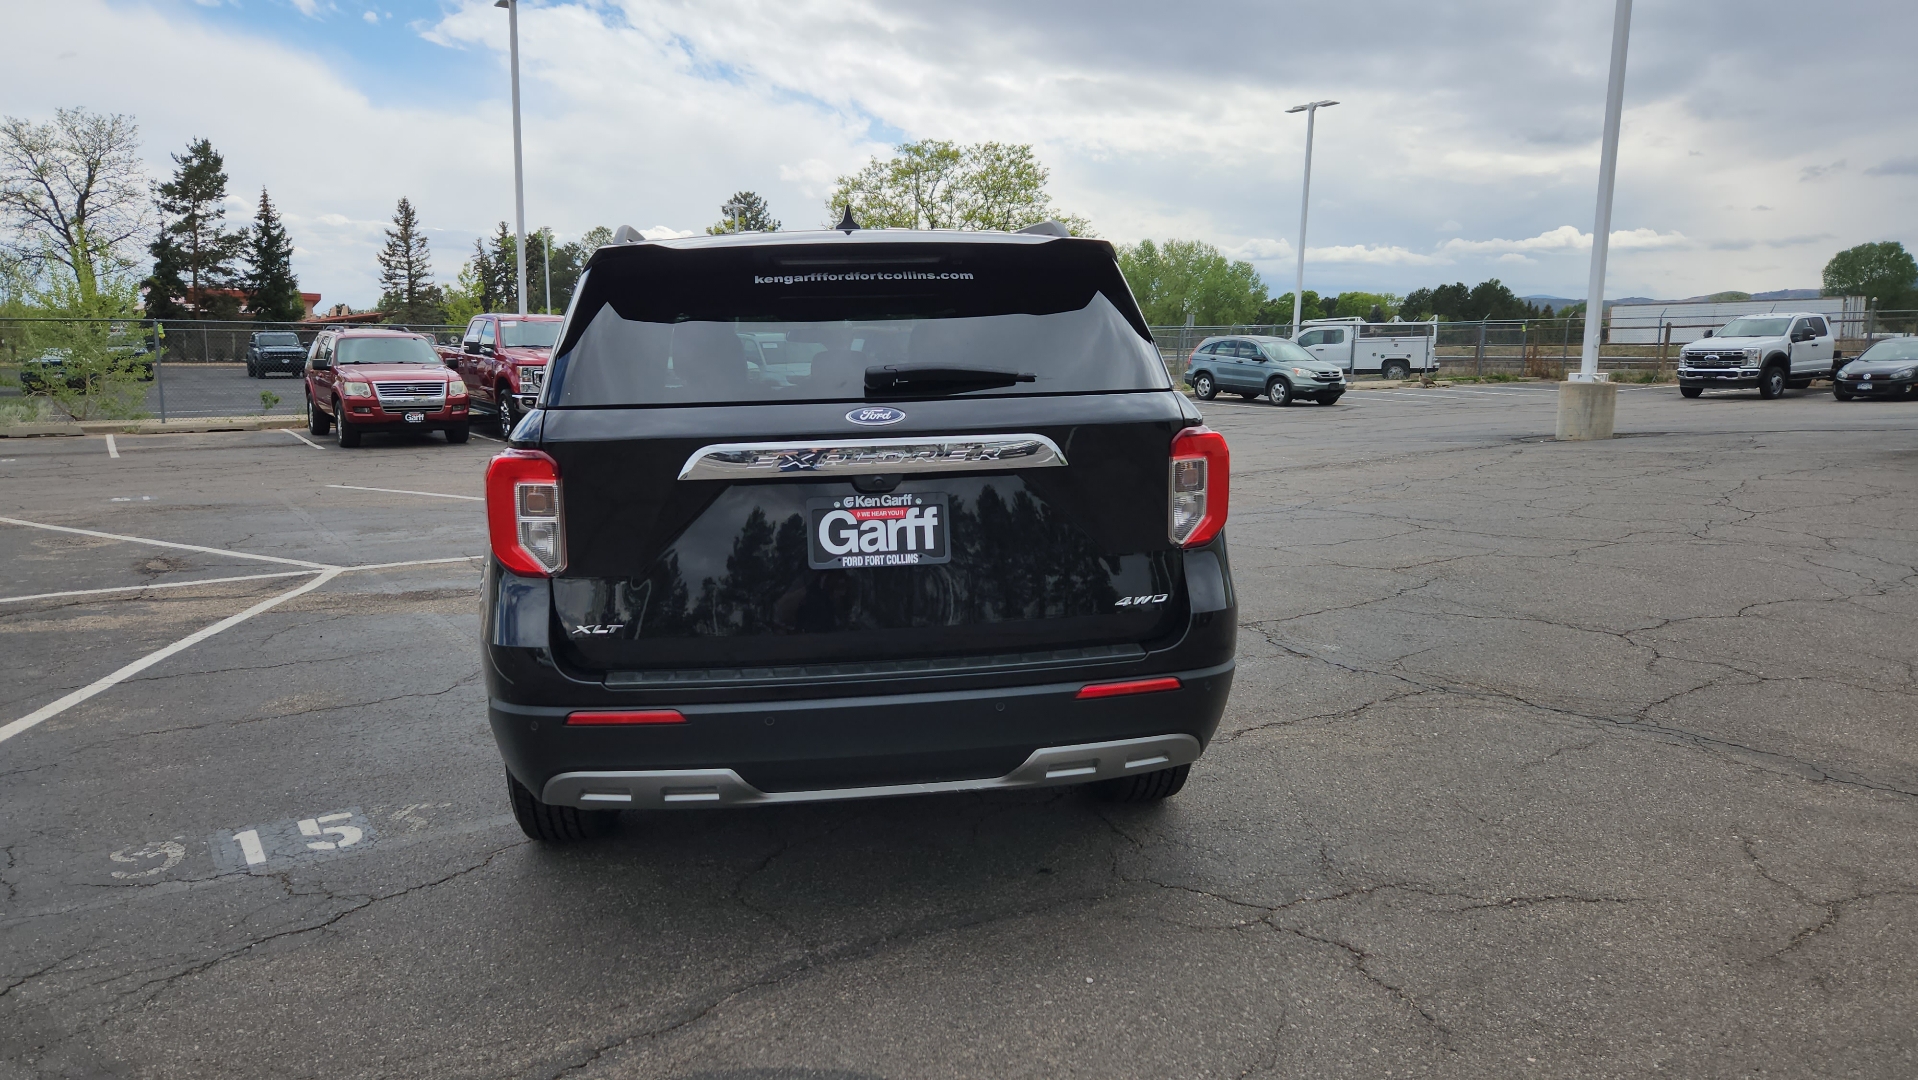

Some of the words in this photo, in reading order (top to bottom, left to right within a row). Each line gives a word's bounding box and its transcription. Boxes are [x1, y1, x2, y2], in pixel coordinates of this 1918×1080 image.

[754, 271, 974, 285] kengarfffordfortcollins.com
[860, 409, 892, 421] Ford
[747, 448, 1002, 469] EXPLORER
[855, 495, 880, 508] Ken
[880, 493, 912, 507] Garff
[818, 506, 939, 555] Garff
[842, 556, 863, 567] FORD
[865, 555, 885, 566] FORT
[887, 553, 919, 565] COLLINS
[1114, 593, 1169, 607] 4WD
[571, 624, 624, 634] XLT
